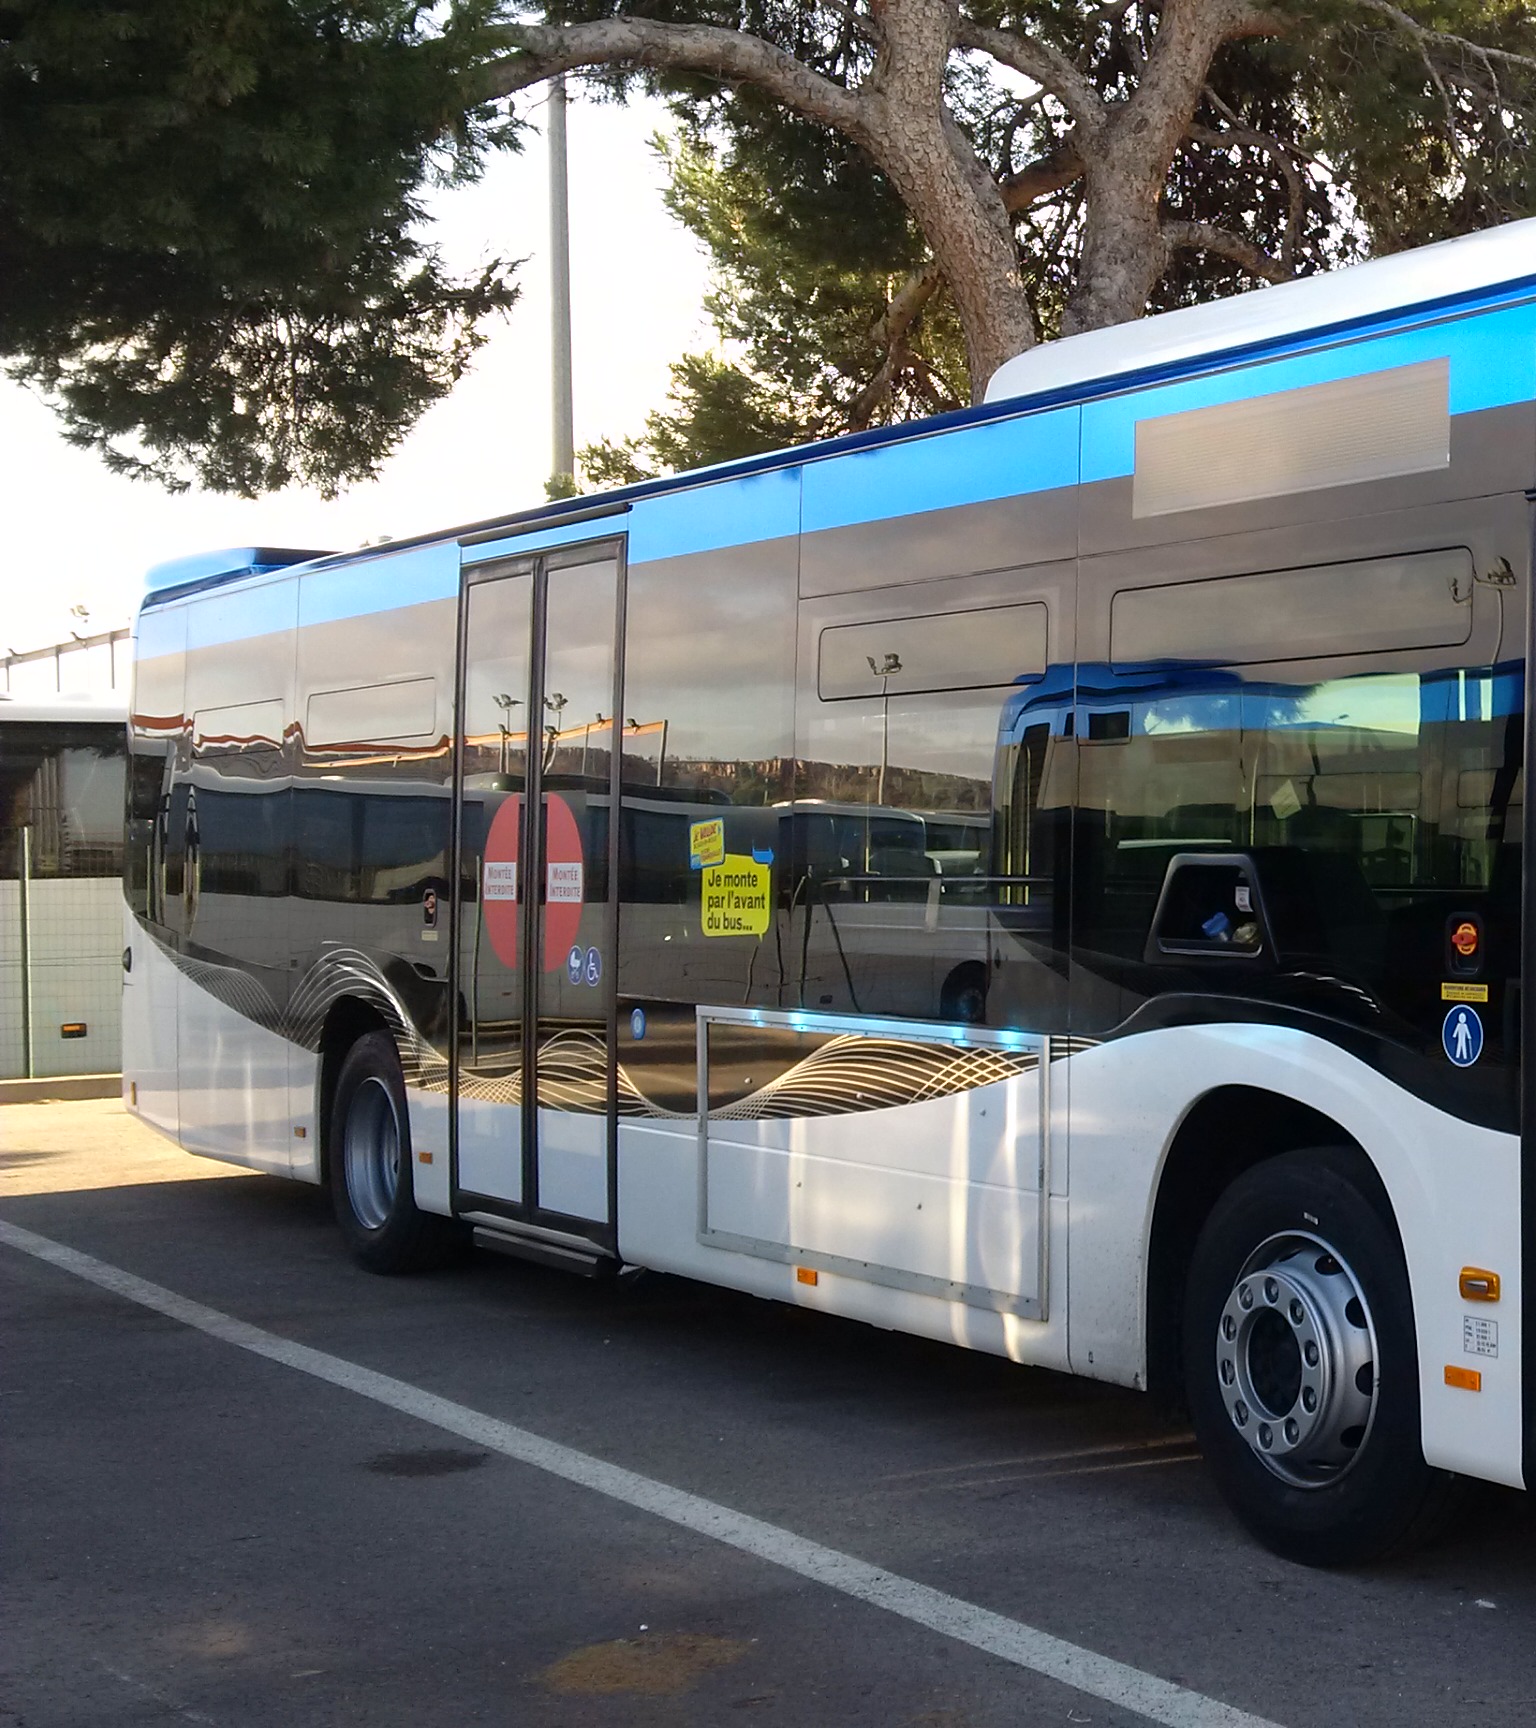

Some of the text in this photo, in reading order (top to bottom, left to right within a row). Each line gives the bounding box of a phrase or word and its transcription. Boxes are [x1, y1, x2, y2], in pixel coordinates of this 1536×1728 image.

[488, 866, 512, 880] MONTÉE
[553, 867, 578, 881] MONTÉE
[708, 869, 758, 888] Je monte
[707, 891, 765, 912] par l'avant
[707, 912, 753, 931] du bus...
